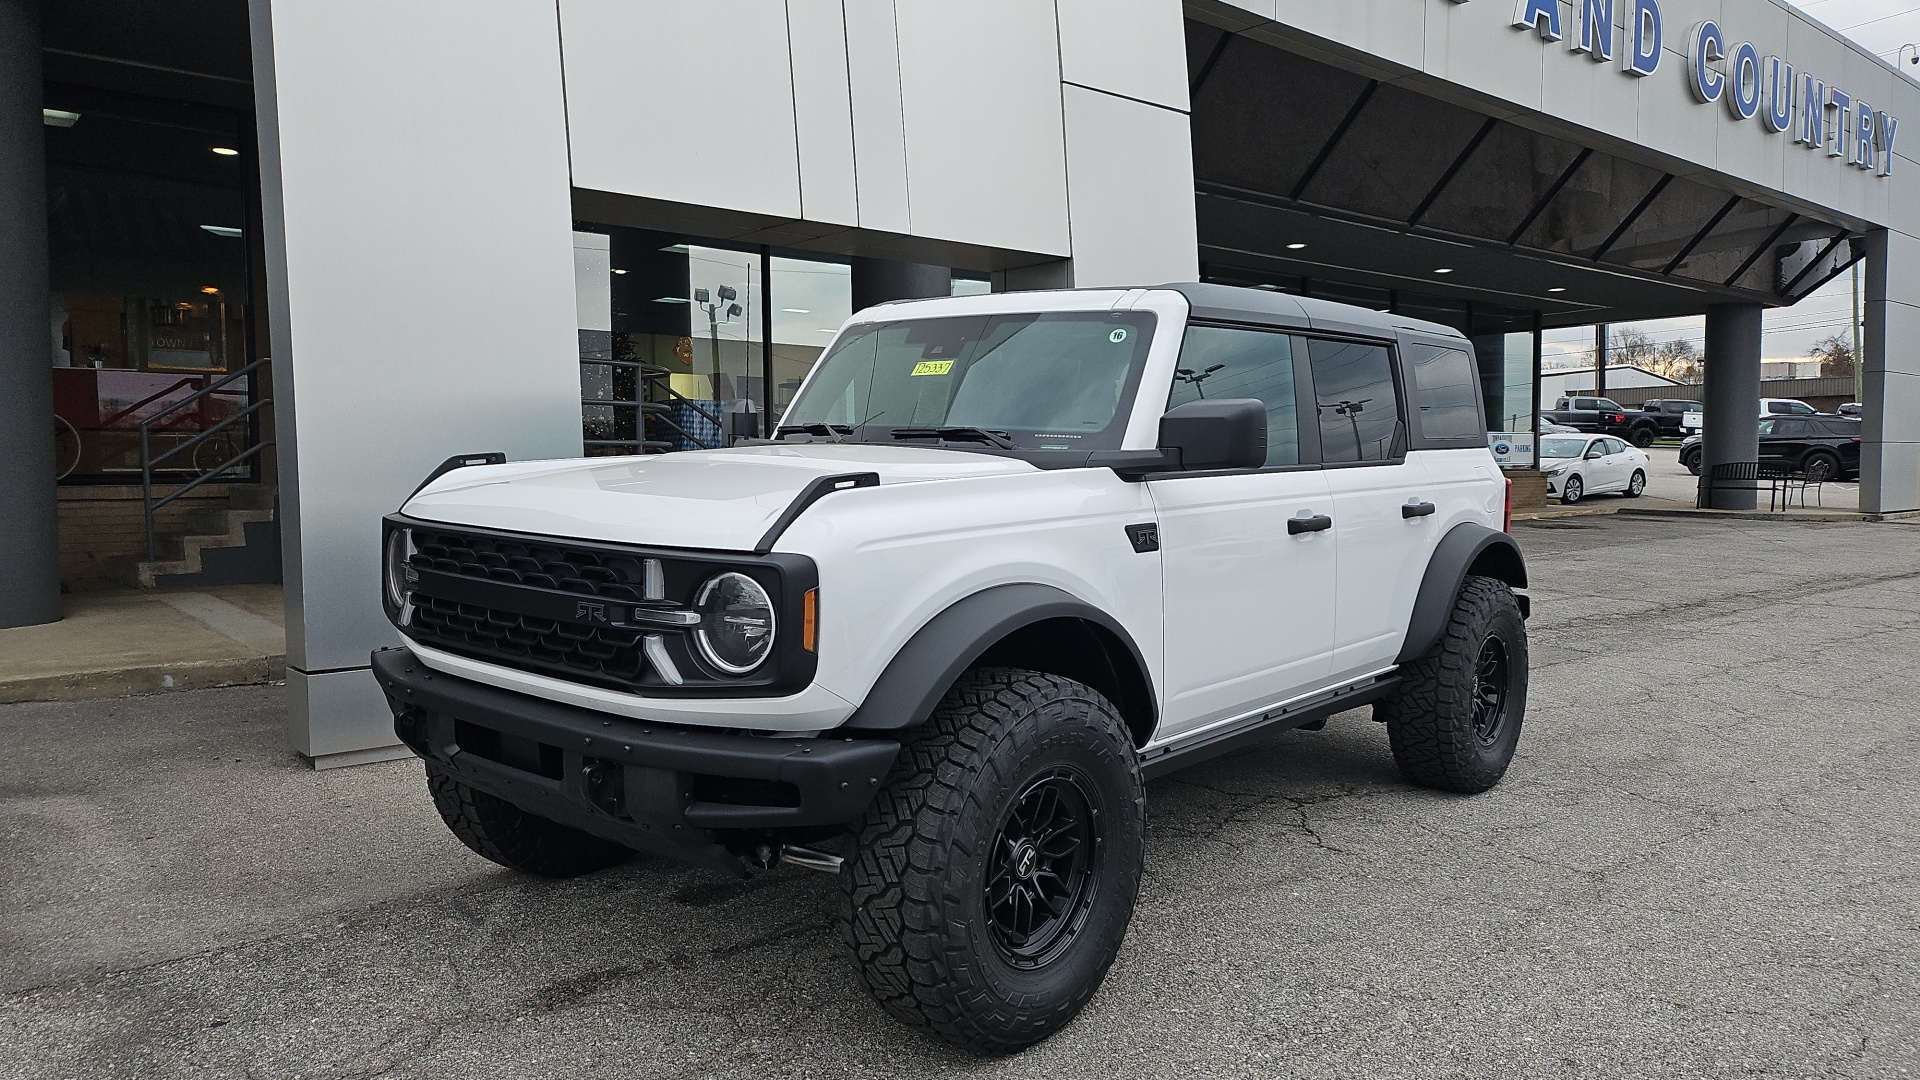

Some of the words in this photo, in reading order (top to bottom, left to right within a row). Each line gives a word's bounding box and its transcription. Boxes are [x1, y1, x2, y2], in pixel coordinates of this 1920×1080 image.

[1687, 20, 1899, 177] COUNTRY
[1112, 331, 1124, 340] 16
[1514, 444, 1531, 453] PARKING
